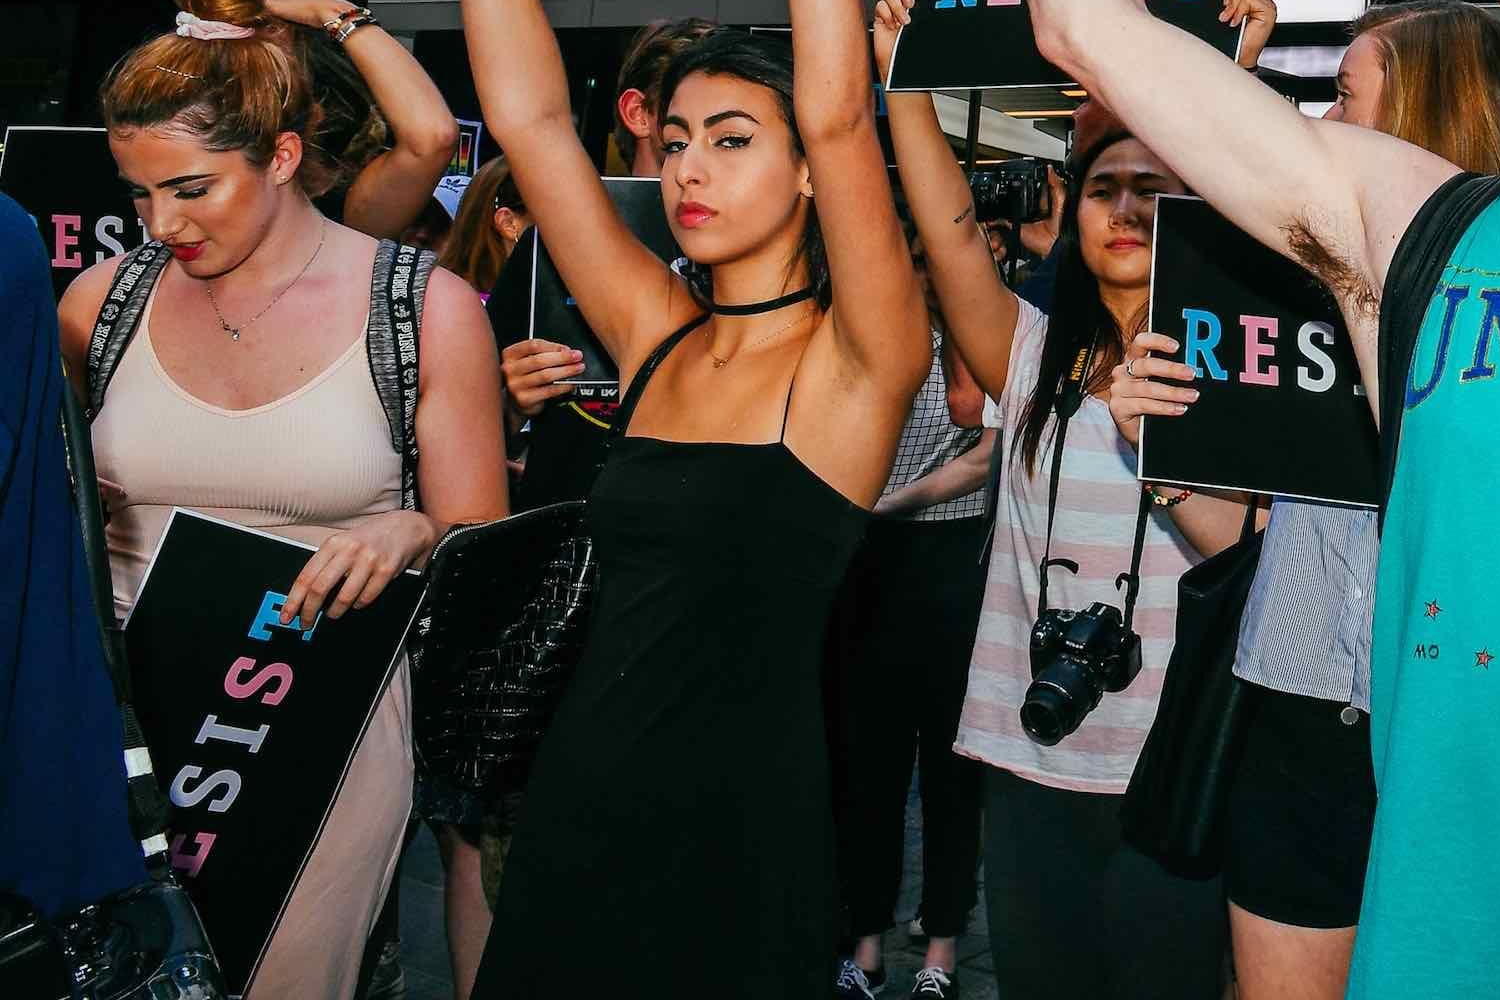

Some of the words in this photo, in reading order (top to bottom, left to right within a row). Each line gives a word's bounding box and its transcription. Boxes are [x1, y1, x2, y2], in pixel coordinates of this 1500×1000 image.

[110, 262, 147, 302] PINK
[391, 265, 411, 300] PINK
[395, 321, 417, 366] PINK
[1071, 348, 1088, 381] Nikon
[1413, 644, 1440, 660] MO
[170, 590, 323, 879] ESIST
